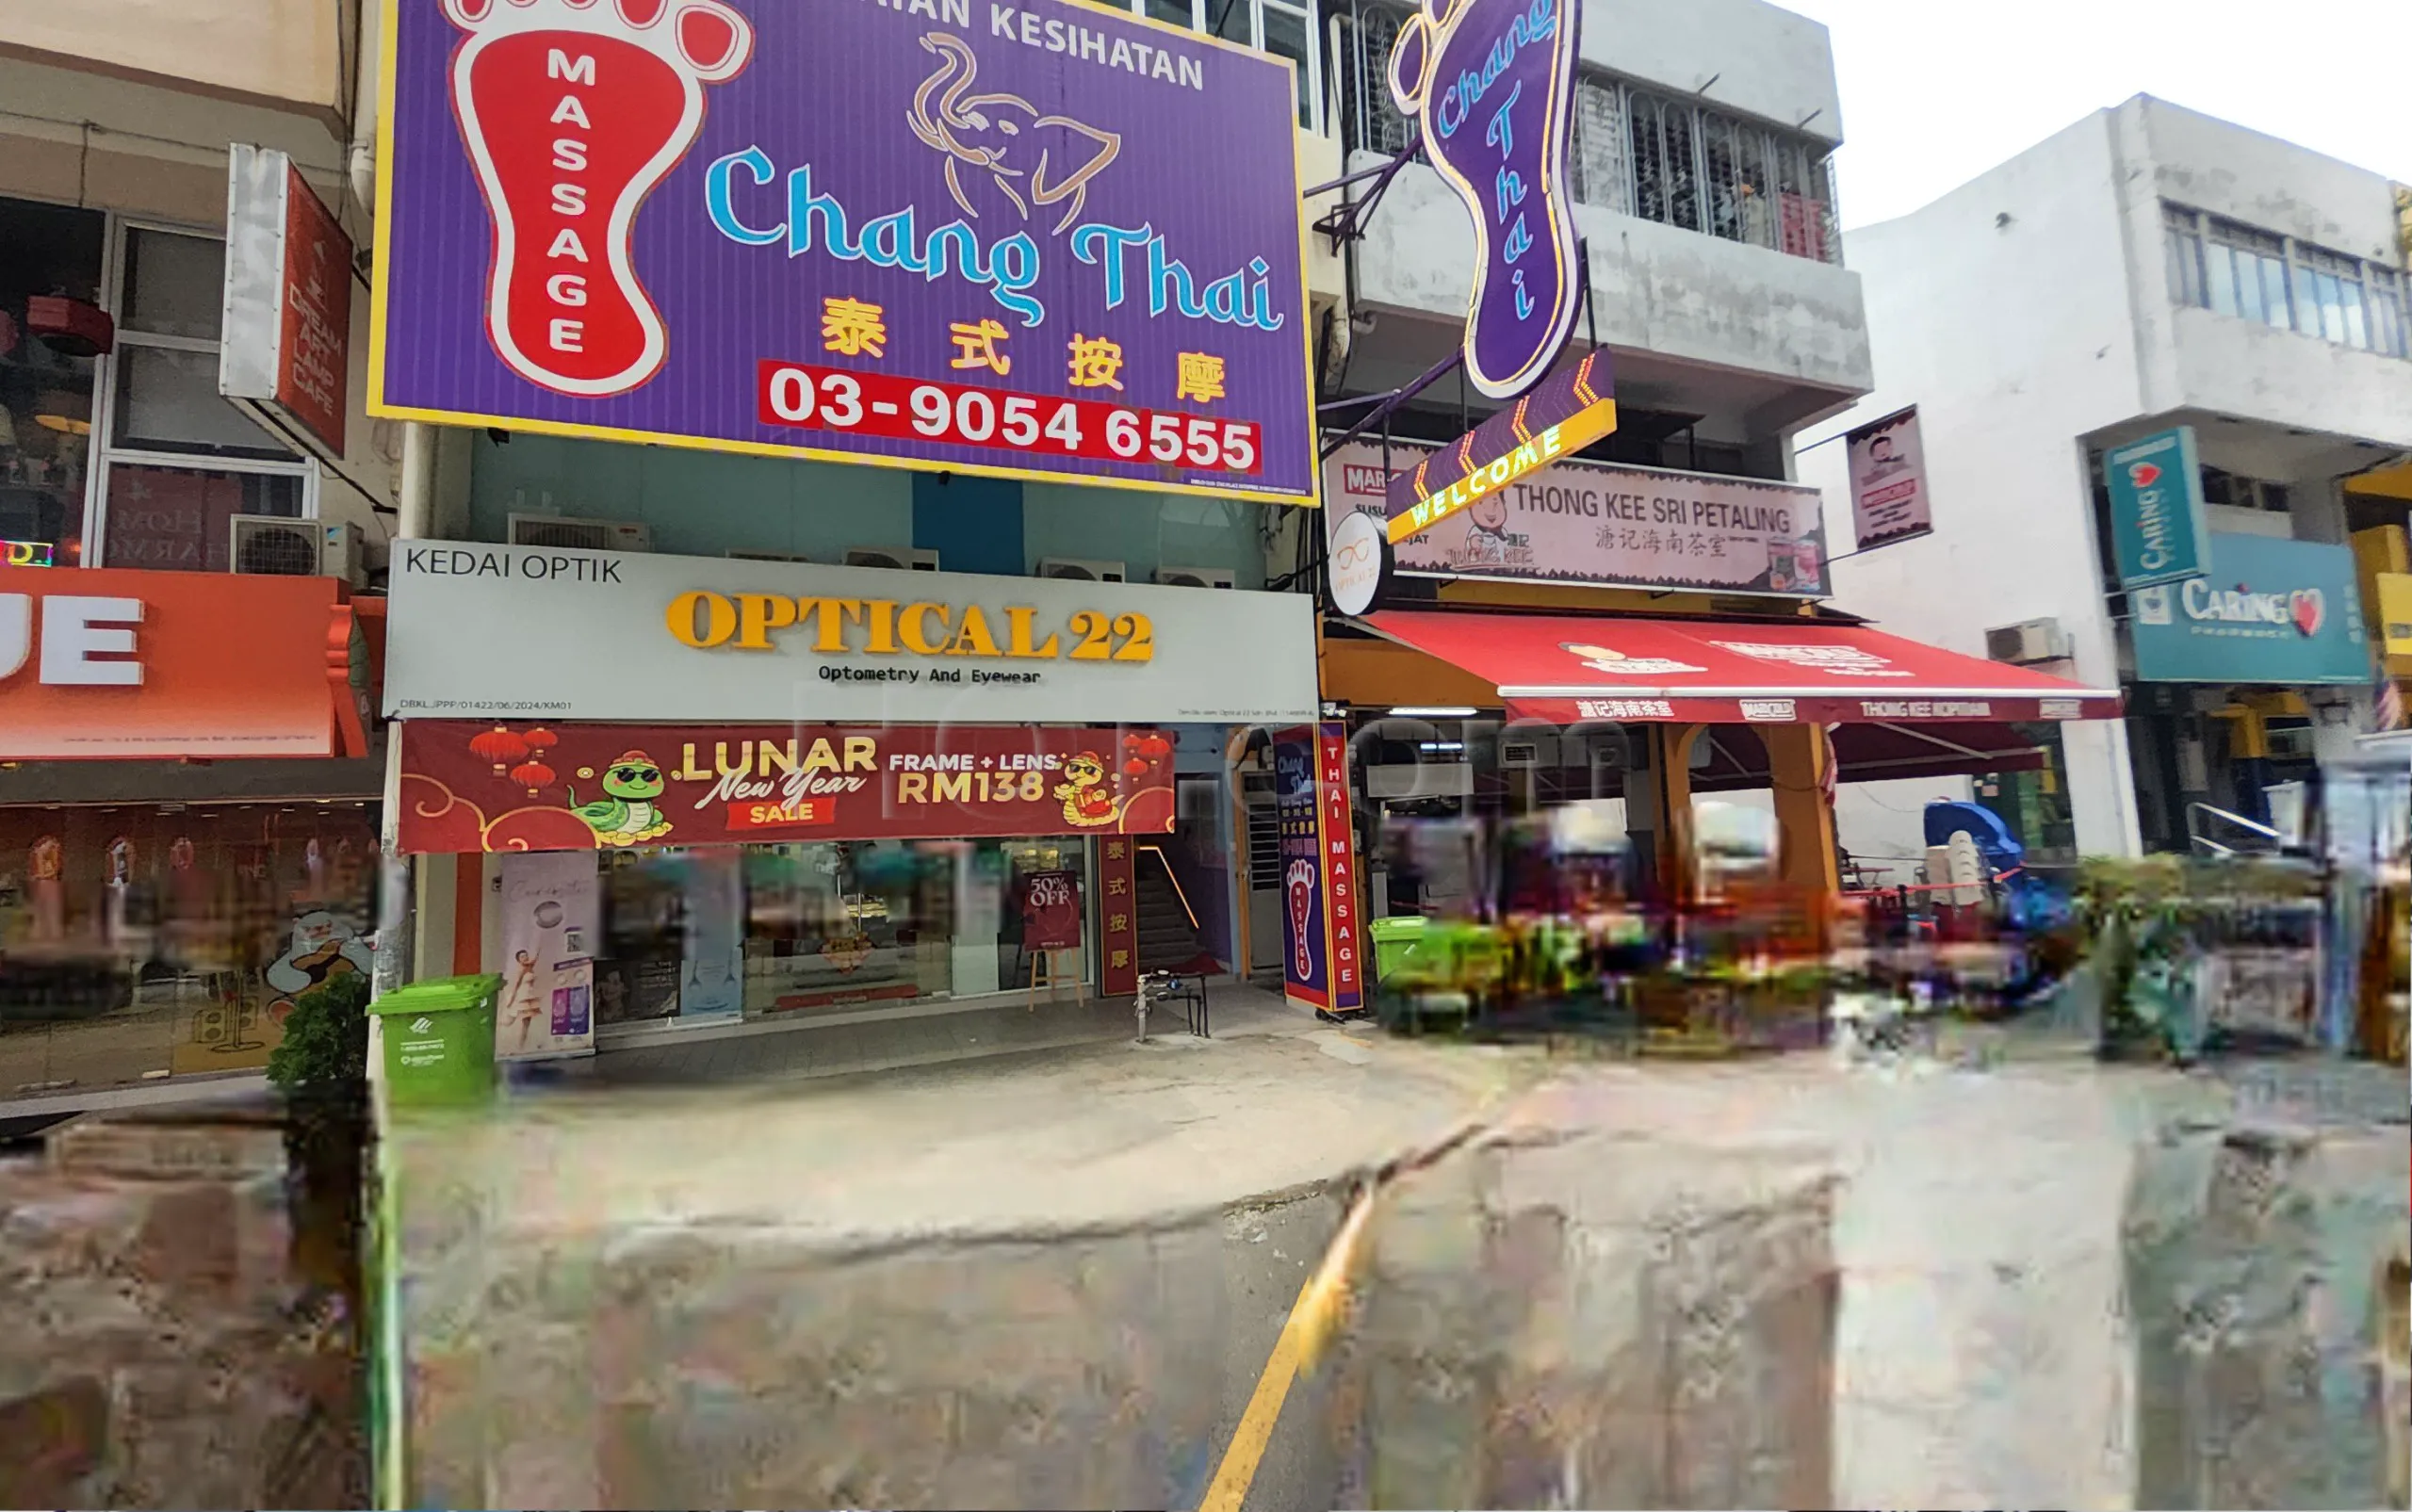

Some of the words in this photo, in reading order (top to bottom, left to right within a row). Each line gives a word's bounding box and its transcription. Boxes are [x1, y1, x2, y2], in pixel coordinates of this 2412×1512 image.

[990, 4, 1203, 91] KESIHATAN
[1438, 0, 1557, 138] Chang
[546, 49, 595, 354] MASSAGE
[1486, 79, 1536, 321] Thai
[704, 144, 1045, 328] Chang
[1070, 221, 1285, 332] Thai
[820, 296, 1227, 404] 泰式按摩
[768, 366, 1084, 452] 03-9054
[1104, 409, 1256, 470] 6555
[1410, 425, 1562, 528] WELCOME
[1512, 483, 1599, 517] THONG
[1605, 492, 1647, 521] KEE
[1653, 497, 1687, 525] SRI
[1693, 501, 1791, 533] PETALING
[406, 547, 510, 577] KEDAI
[521, 554, 623, 583] OPTIK
[666, 591, 1059, 659] OPTICAL
[1069, 610, 1155, 662] 22
[818, 665, 920, 683] Optometry
[929, 668, 961, 683] And
[971, 669, 1041, 686] Eyewear
[683, 736, 878, 781] LUNAR
[693, 768, 774, 809] New
[778, 766, 867, 811] Year
[889, 755, 974, 771] FRAME
[999, 754, 1056, 771] LENS
[898, 772, 1046, 804] RM138
[1327, 747, 1343, 819] THAI
[750, 803, 814, 823] SALE
[1030, 889, 1070, 907] OFF
[1031, 876, 1069, 893] 50%
[1331, 840, 1352, 983] MASSAGE
